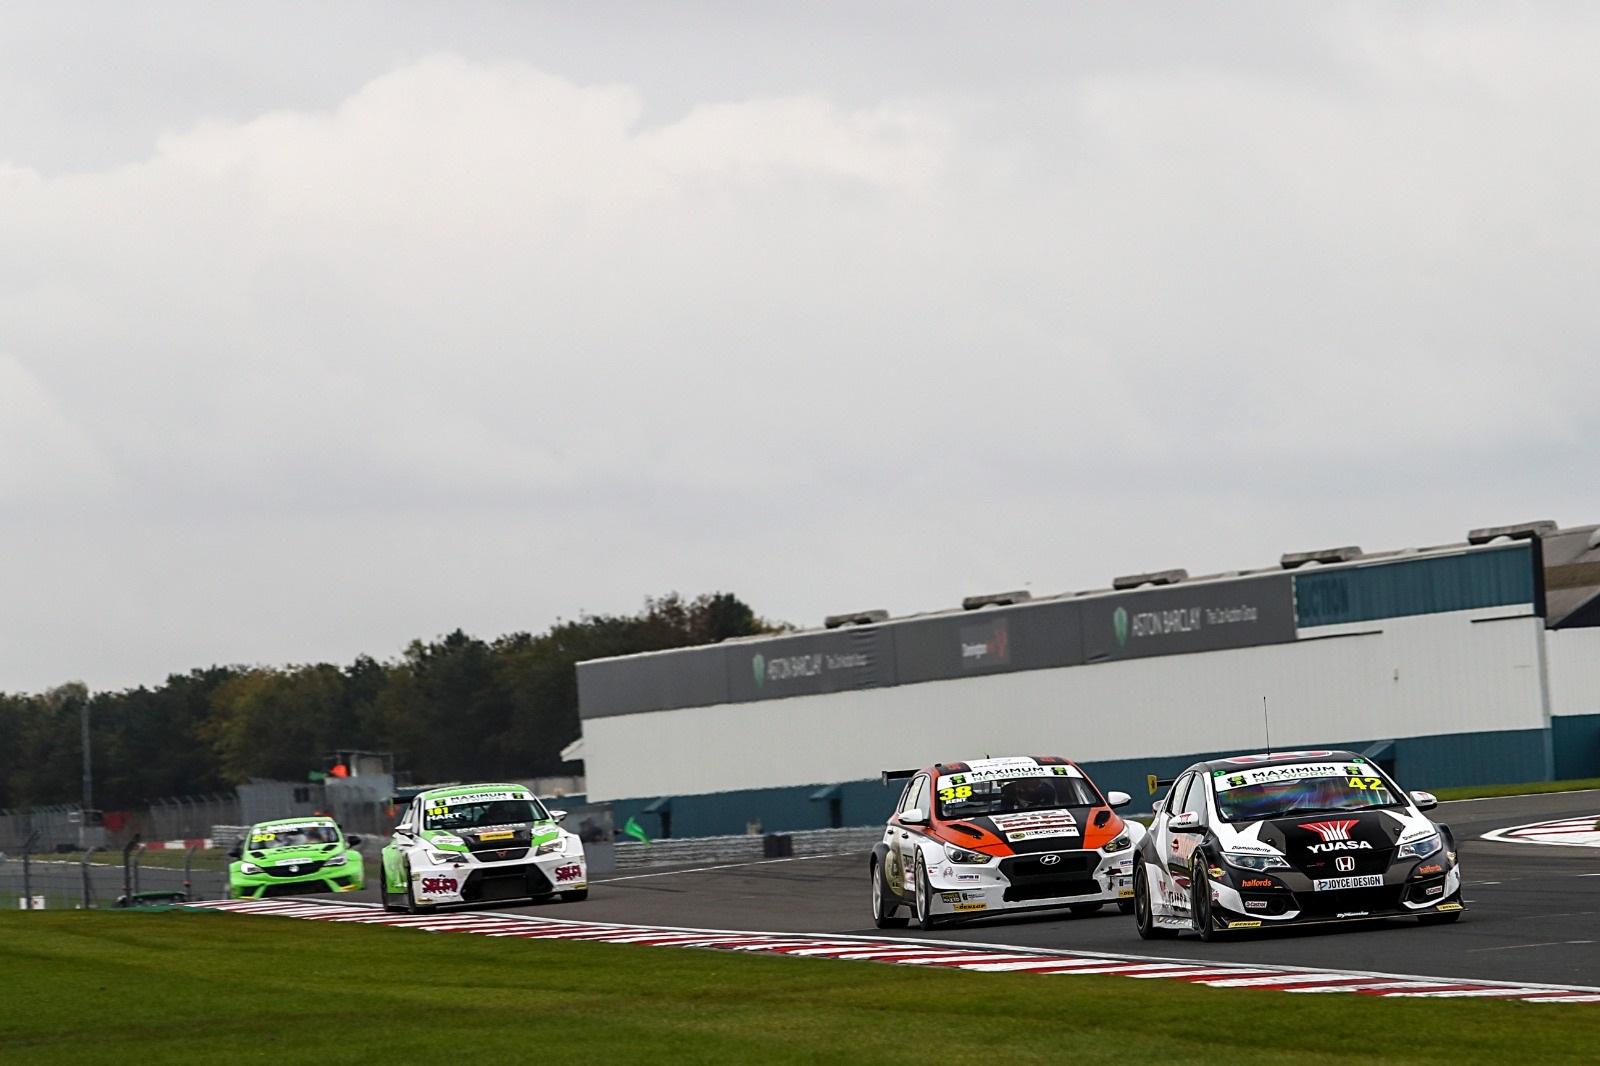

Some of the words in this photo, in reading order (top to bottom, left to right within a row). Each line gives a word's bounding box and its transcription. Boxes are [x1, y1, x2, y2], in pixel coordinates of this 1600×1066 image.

[971, 767, 1044, 778] MAXIMUM
[1252, 766, 1336, 778] MAXIMUM
[1254, 771, 1338, 783] NETWORKS
[1349, 777, 1386, 791] 42
[450, 792, 507, 802] MAXIMUM
[939, 785, 973, 801] 38
[946, 797, 967, 805] KENT
[426, 812, 462, 821] HART
[427, 806, 449, 816] 101
[1231, 845, 1271, 853] Diamondbrite
[1306, 840, 1373, 854] YUASA
[1242, 879, 1272, 887] halfords
[1328, 878, 1350, 889] JOYCE
[1353, 876, 1381, 887] DESIGN
